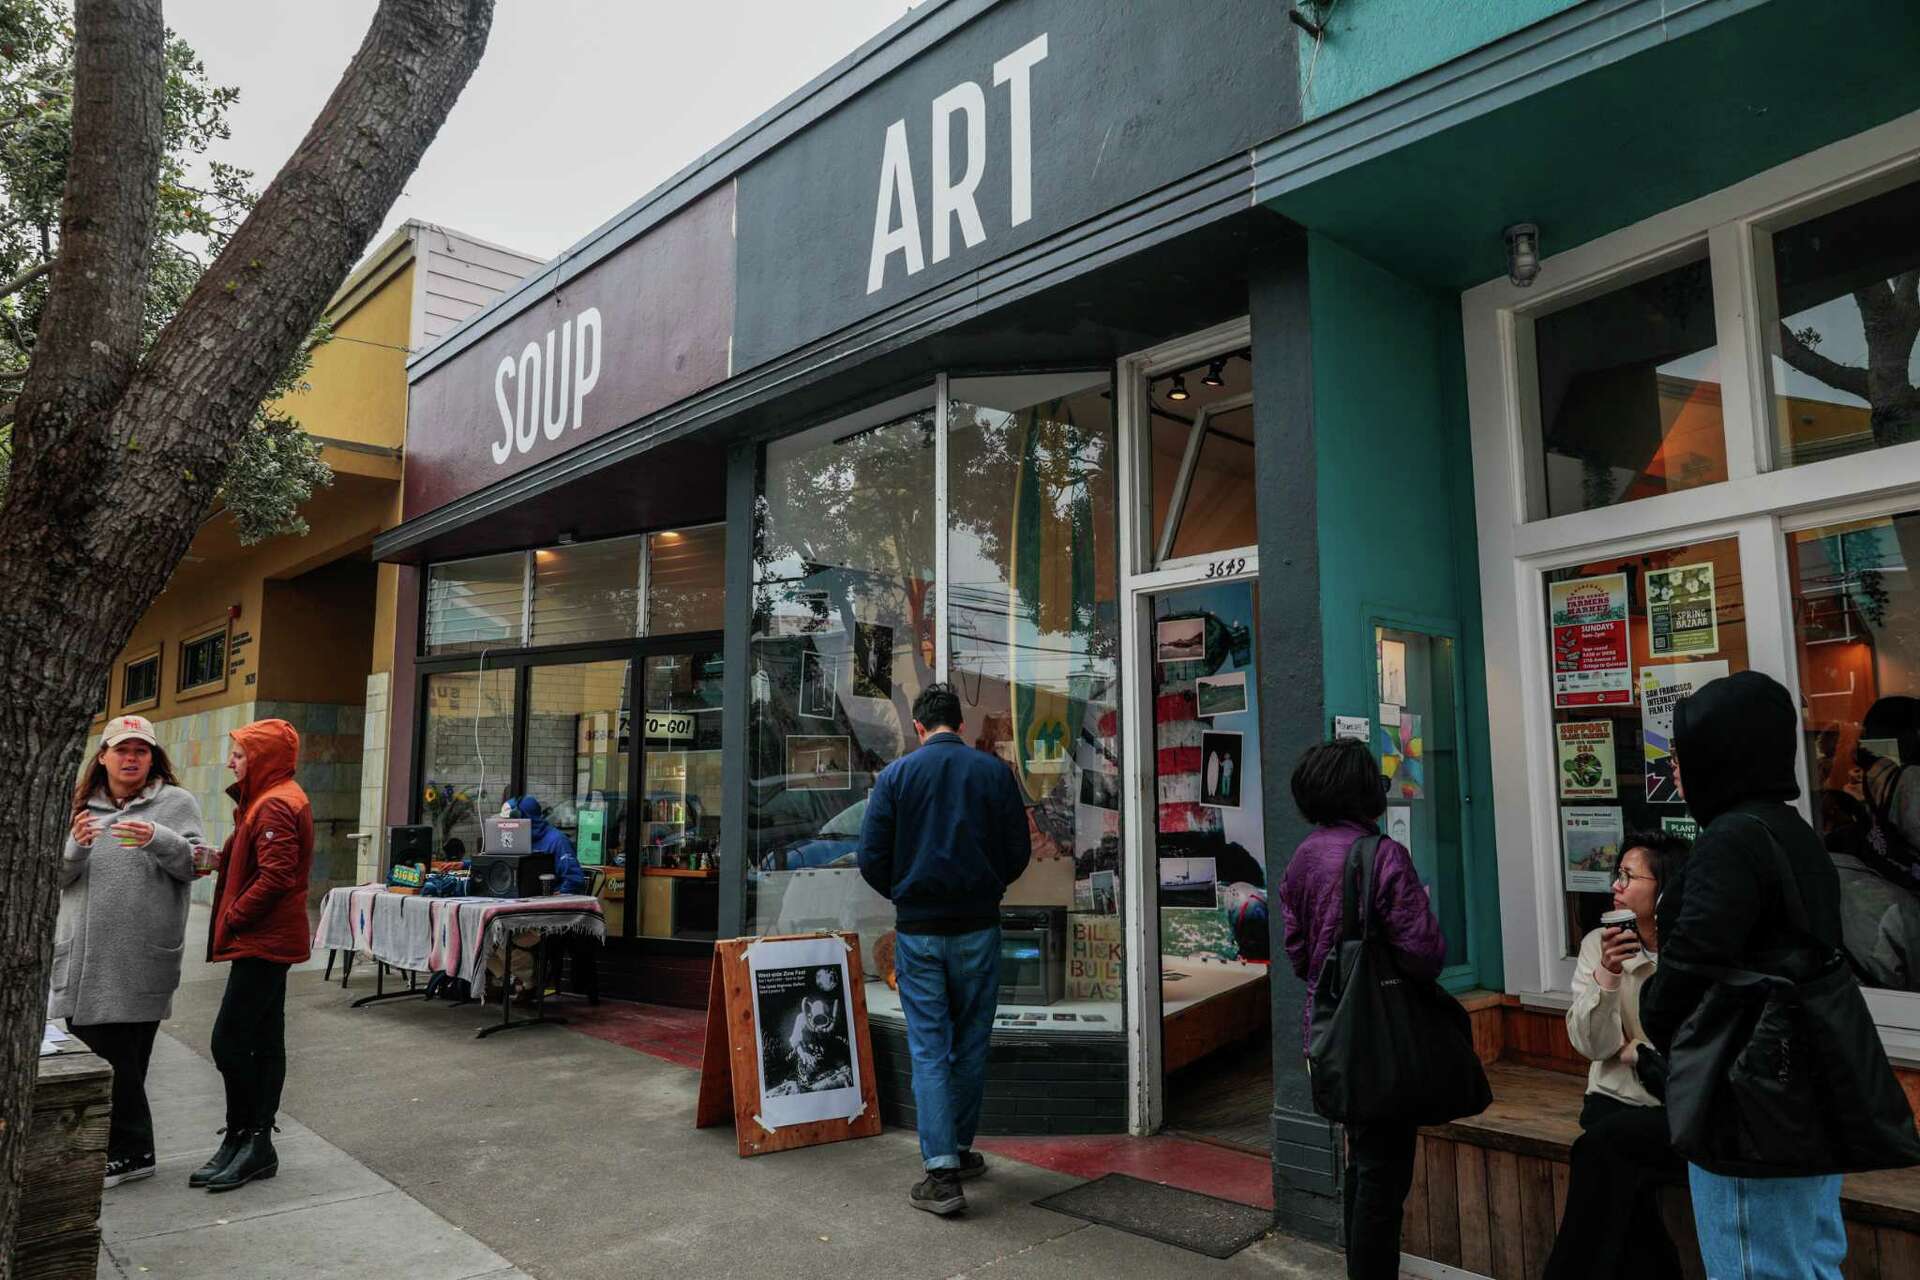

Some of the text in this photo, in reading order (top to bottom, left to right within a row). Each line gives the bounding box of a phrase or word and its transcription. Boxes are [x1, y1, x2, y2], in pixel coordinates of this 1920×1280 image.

[866, 32, 1048, 296] ART
[491, 307, 602, 465] SOUP
[1205, 558, 1245, 578] 3649
[1567, 597, 1610, 608] FARMERS
[1676, 608, 1707, 620] SPRING
[1581, 623, 1614, 632] SUNDAYS
[1675, 617, 1709, 629] BAZAAR
[1645, 688, 1659, 698] SAN
[1659, 682, 1693, 696] FRANCISCO
[1649, 704, 1664, 716] FILM
[1670, 824, 1696, 833] PLANT
